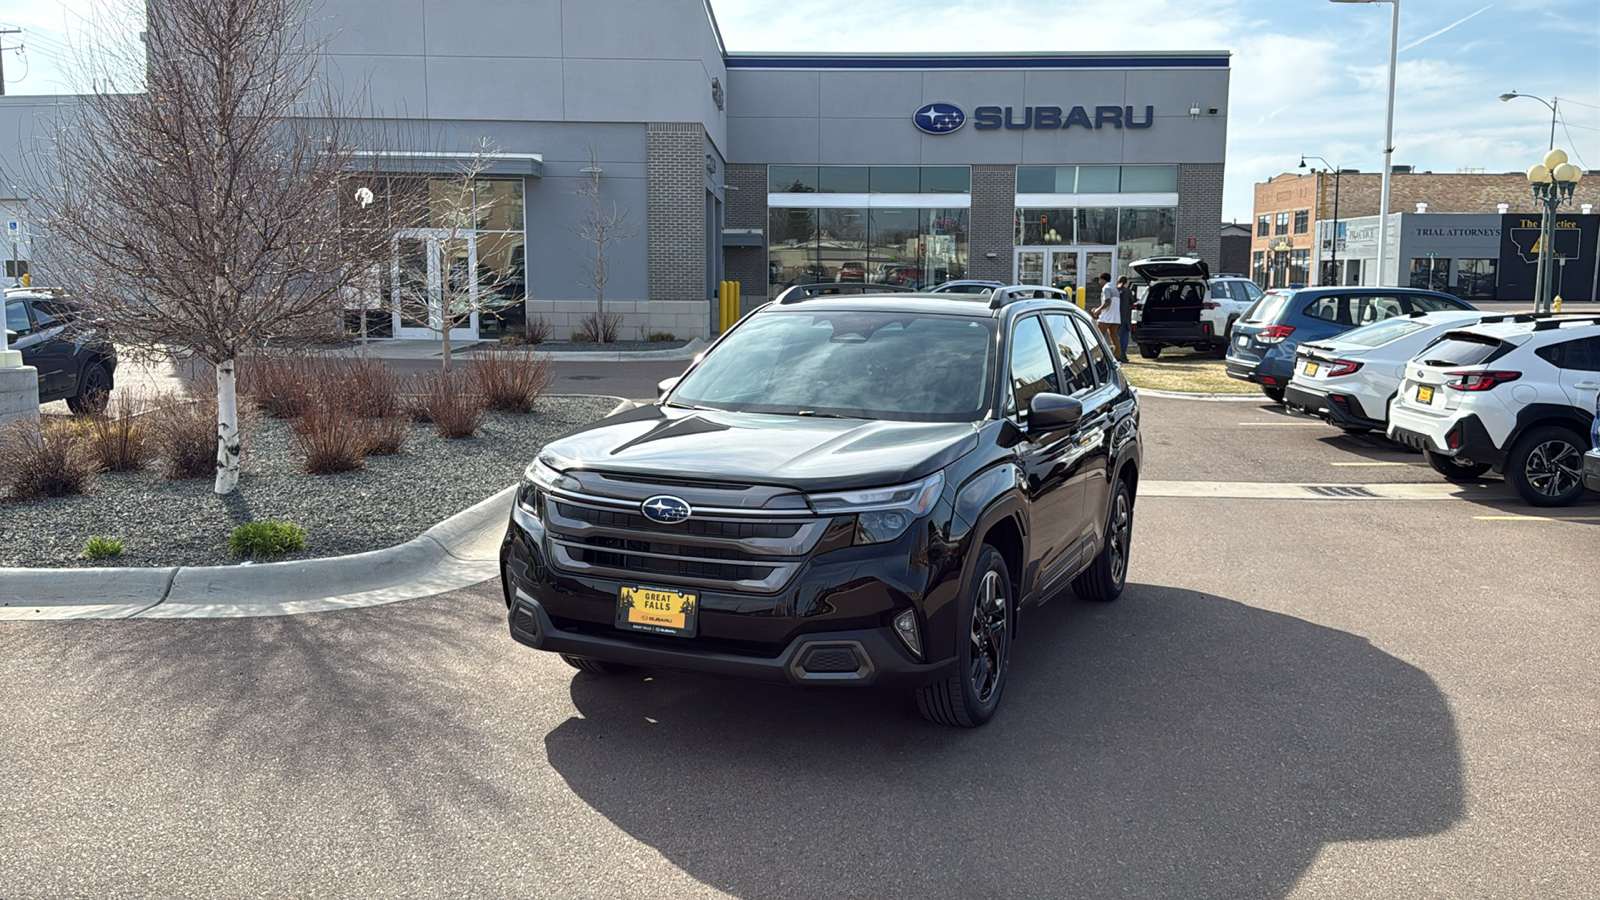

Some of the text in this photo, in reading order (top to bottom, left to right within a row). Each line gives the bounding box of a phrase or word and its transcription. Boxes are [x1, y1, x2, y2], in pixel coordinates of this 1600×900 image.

[974, 105, 1153, 130] SUBARU
[1520, 219, 1577, 228] The ctice
[1416, 228, 1501, 236] TRIAL ATTORNEYS
[645, 593, 671, 602] GREAT
[644, 601, 670, 611] FALLS
